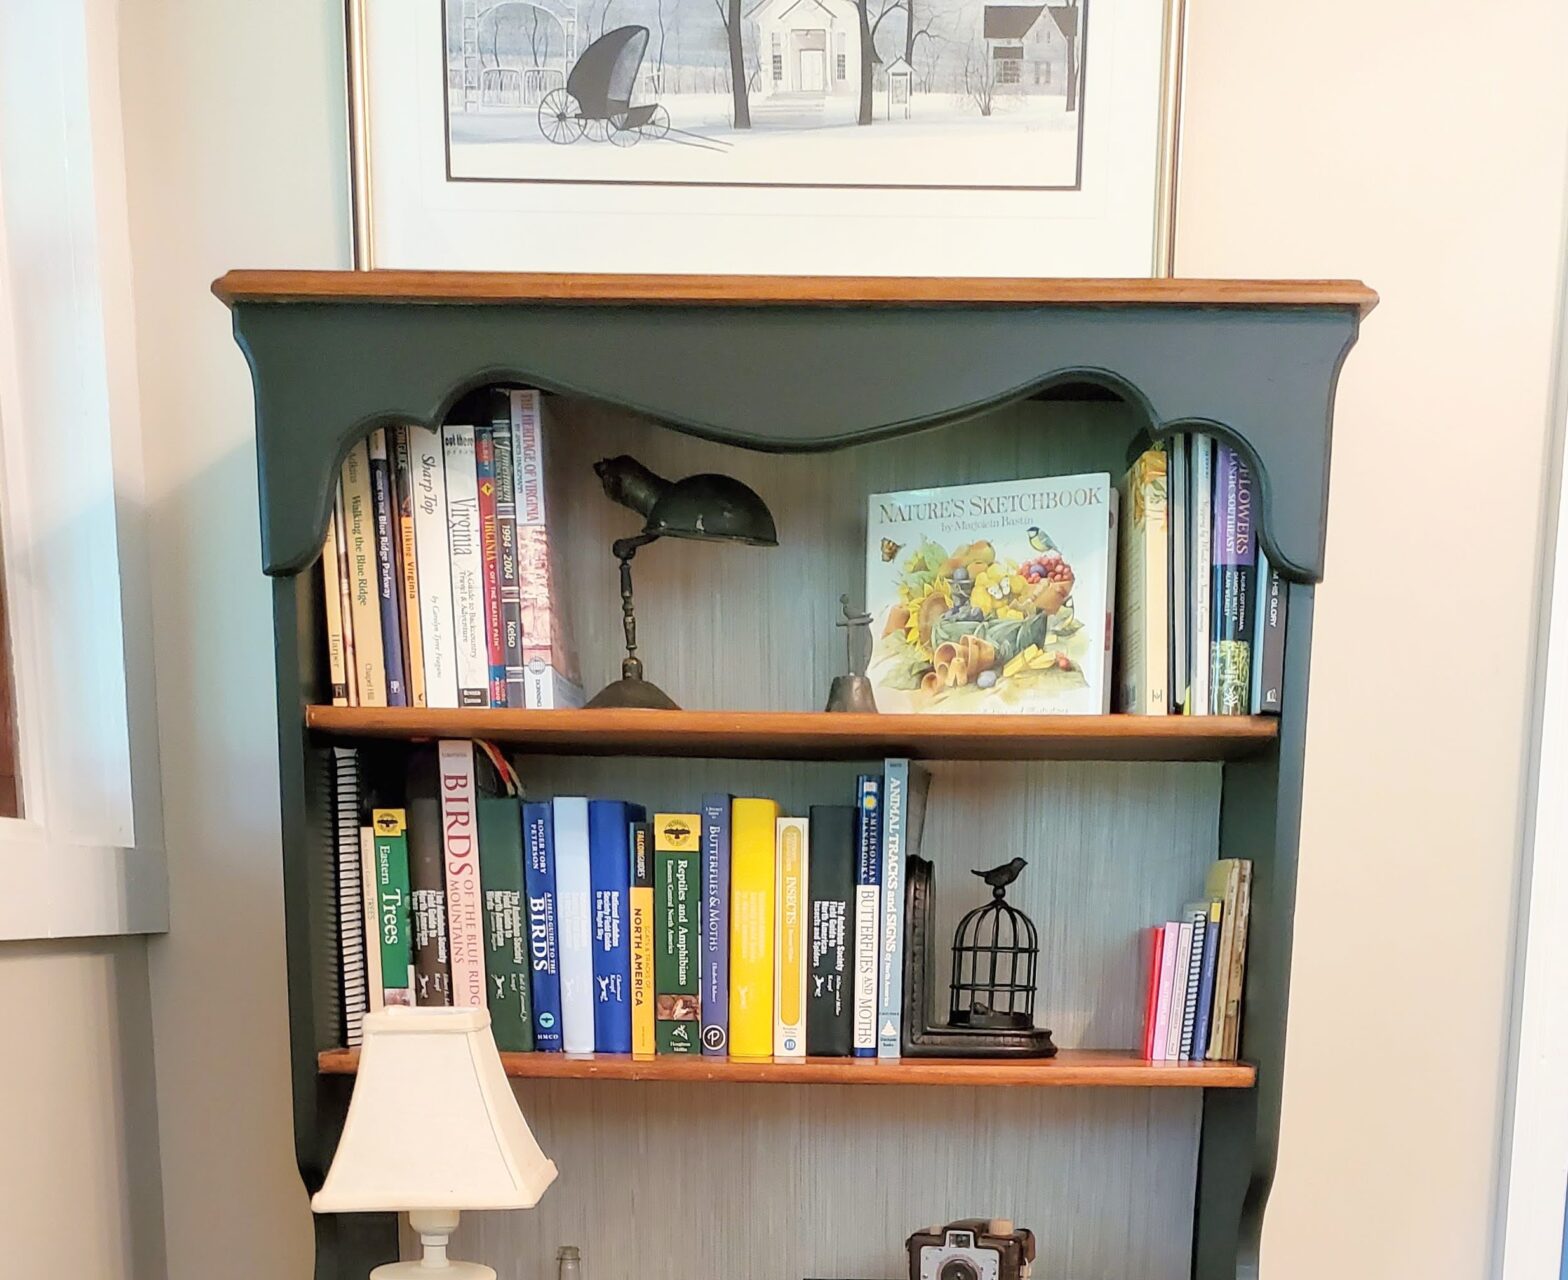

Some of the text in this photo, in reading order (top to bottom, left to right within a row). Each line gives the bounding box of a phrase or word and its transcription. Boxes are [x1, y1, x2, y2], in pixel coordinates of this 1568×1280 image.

[494, 441, 512, 502] Jamestown
[520, 393, 539, 522] THE HERITAGE OF VIRGINIA
[418, 455, 438, 516] Sharp Top
[878, 486, 1103, 525] NATURE'S SKETCHBOOK
[449, 497, 478, 556] Virginia
[484, 514, 497, 562] VIRGINIA
[940, 521, 953, 533] by
[1225, 493, 1237, 554] SOUTHEAST
[352, 495, 369, 606] Walking the Blue Ridge
[378, 515, 392, 599] Blue Ridge Parkway
[502, 525, 513, 579] 1994 2004
[406, 562, 416, 600] Virginia
[1271, 582, 1279, 597] HIS
[506, 621, 517, 648] Kelso
[443, 774, 474, 877] BIRDS
[889, 778, 901, 836] ANIMAL
[380, 845, 390, 885] Eastern
[531, 824, 540, 870] PETERSON
[537, 819, 547, 874] ROGER TORY
[708, 825, 721, 895] BUTTERFLIES
[861, 817, 869, 878] HANDBOOKS
[867, 812, 877, 883] SMITHSONIAN
[887, 834, 900, 889] TRACKS
[367, 897, 376, 921] TREES
[383, 888, 402, 945] Trees
[450, 881, 464, 963] MOUNTAINS
[510, 890, 520, 905] The
[547, 899, 555, 921] FIELD
[708, 896, 720, 908] &
[785, 875, 798, 925] INSECTS
[836, 901, 846, 915] The
[887, 891, 897, 914] and
[463, 880, 481, 1005] OF THE BLUE RIDG
[530, 896, 548, 972] BIRDS
[548, 922, 556, 947] GUIDE
[668, 929, 676, 955] America
[676, 860, 689, 986] Reptiles and Amphibians
[708, 909, 721, 952] MOTHS
[821, 901, 830, 955] North American
[828, 901, 838, 947] Field Guide to
[886, 914, 899, 952] SIGNS
[549, 947, 556, 958] TO
[634, 908, 644, 1007] NORTH AMERICA
[835, 945, 845, 972] Society
[859, 891, 876, 1045] BUTTERFLIES AND MOTHS
[884, 954, 891, 962] of
[883, 983, 891, 1008] America
